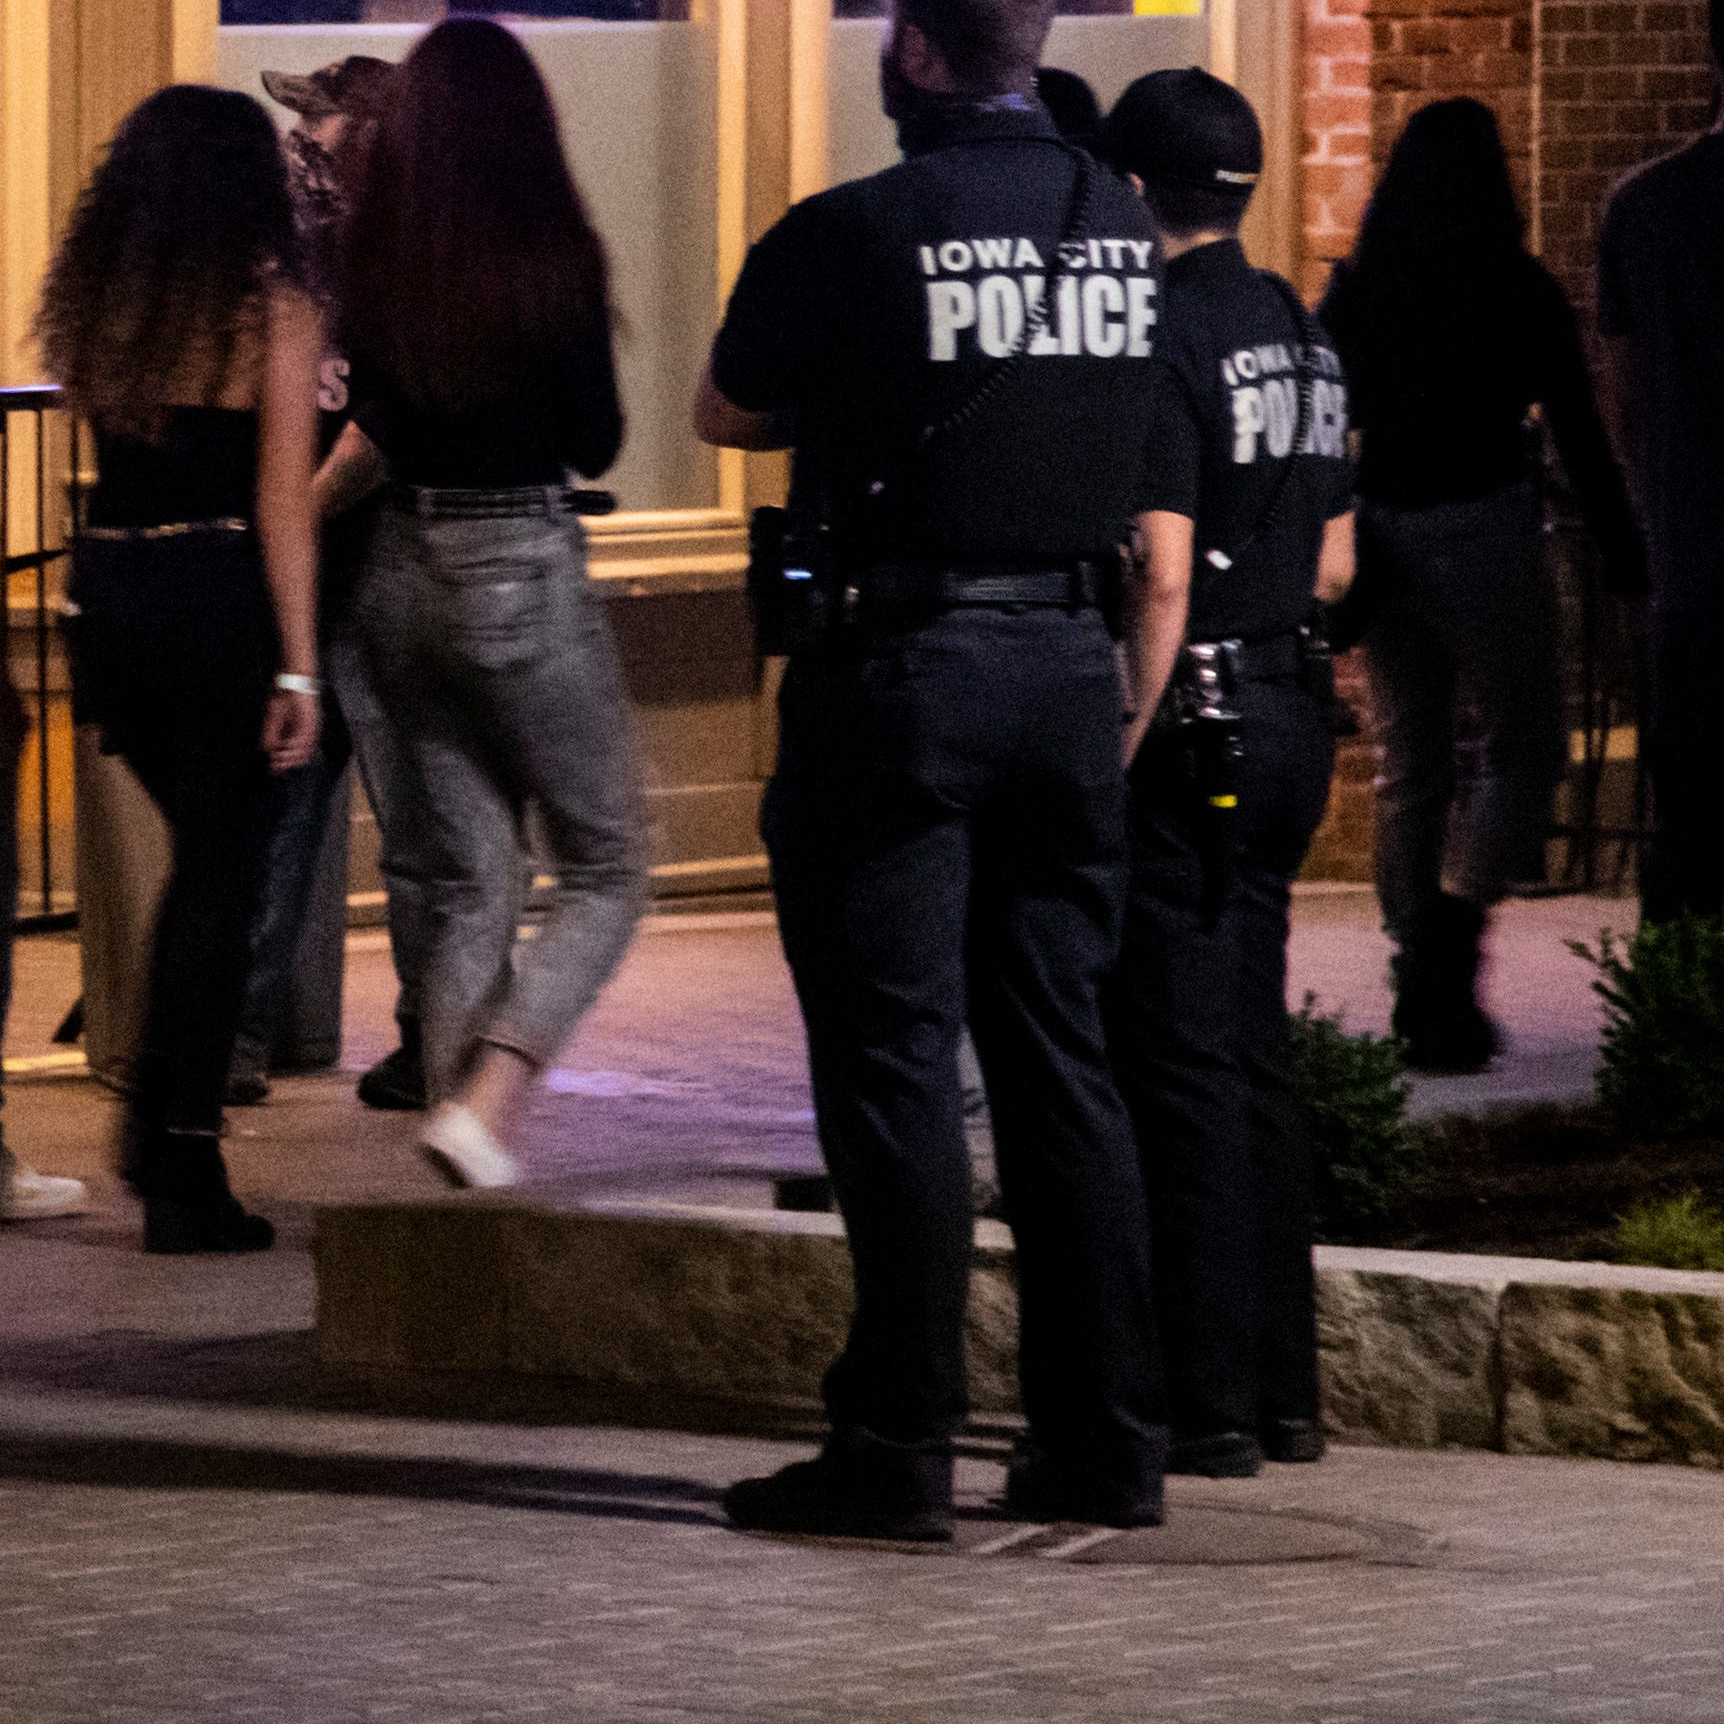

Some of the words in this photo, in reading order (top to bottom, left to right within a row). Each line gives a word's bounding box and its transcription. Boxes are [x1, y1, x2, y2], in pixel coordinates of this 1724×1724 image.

[919, 237, 1045, 275] IOWA
[1057, 239, 1154, 270] CITY
[926, 275, 1158, 361] POLICE
